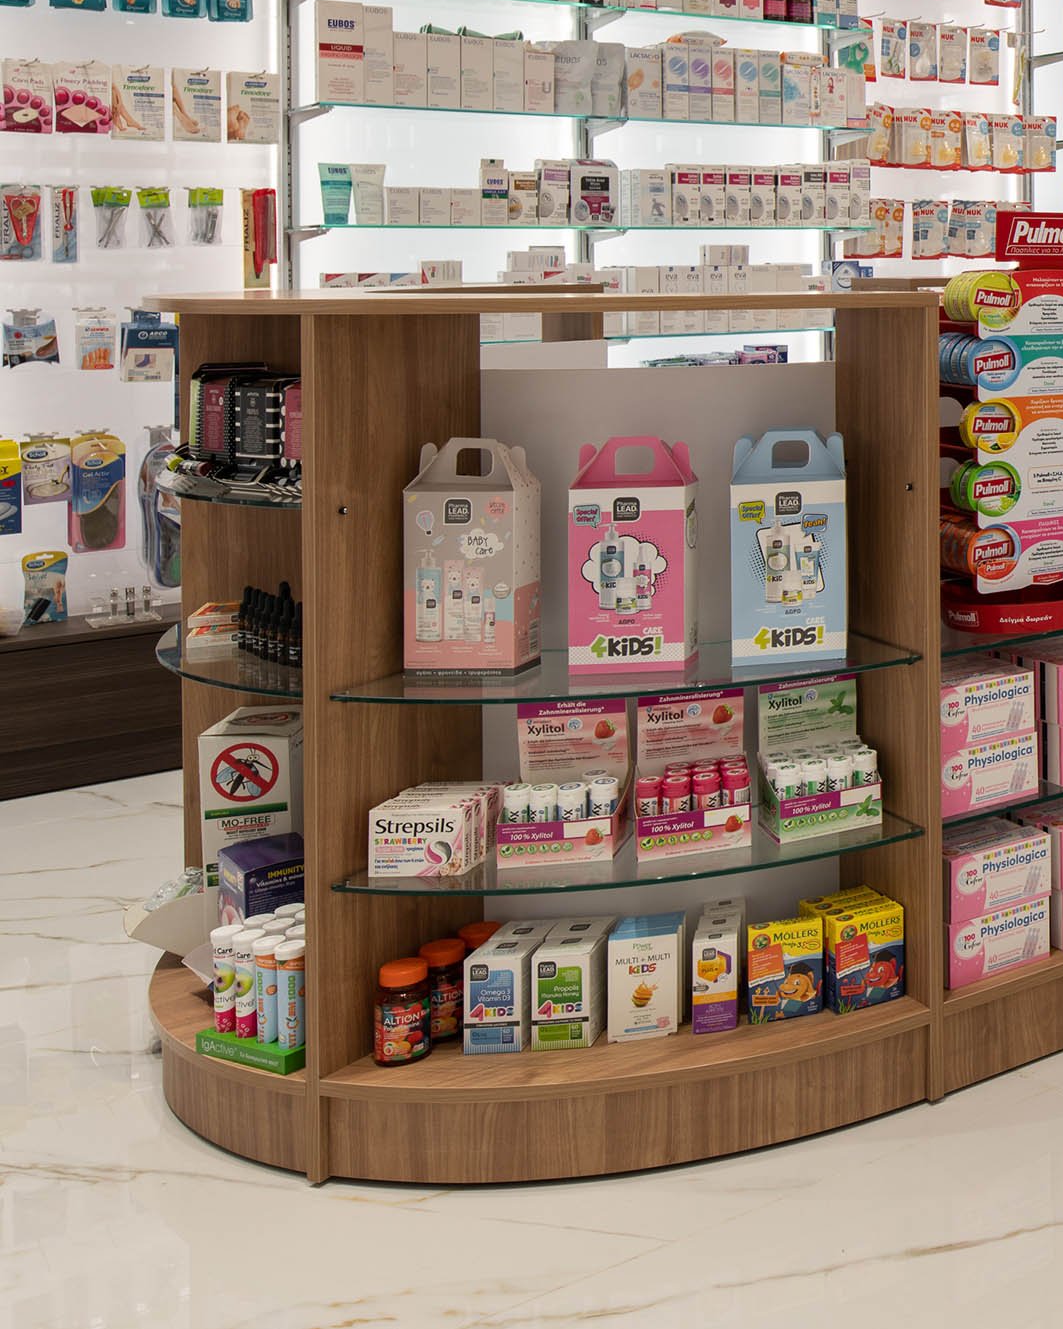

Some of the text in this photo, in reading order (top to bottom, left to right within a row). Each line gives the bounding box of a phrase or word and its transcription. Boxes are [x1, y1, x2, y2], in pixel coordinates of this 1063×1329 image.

[327, 18, 355, 28] EUBOS
[883, 25, 895, 33] NUK
[910, 30, 924, 38] NUK
[941, 33, 954, 41] NUK
[970, 36, 985, 44] NUK
[931, 118, 945, 126] NUK
[994, 121, 1009, 129] NUK
[921, 208, 934, 216] NUK
[966, 208, 982, 216] NUK
[976, 290, 1011, 307] Pulmoll
[976, 353, 1011, 372] Pulmoll
[975, 420, 1010, 431] Pulmoll
[976, 479, 1009, 496] Pulmoll
[779, 499, 799, 507] LEAD
[575, 508, 598, 516] Special
[616, 505, 637, 513] LEAD
[467, 536, 488, 546] BABY
[975, 541, 1010, 559] Pulmoll
[964, 684, 1029, 708] Physiologica
[768, 696, 803, 711] Xylitol
[948, 702, 960, 710] 100
[647, 711, 684, 724] Xylitol
[527, 723, 565, 737] Xylitol
[967, 745, 1033, 769] Physiologica
[950, 763, 963, 772] 100
[792, 802, 832, 815] 100 % Xylitol
[221, 815, 271, 828] MO-FREE
[375, 817, 454, 838] Strepsils
[651, 822, 694, 833] 100 % Xylitol
[375, 837, 427, 845] STRAWBERRY
[531, 832, 554, 841] Xylitol
[982, 847, 1047, 873] Physiologica
[966, 869, 978, 878] 100
[980, 910, 1045, 937] Physiologica
[963, 933, 976, 943] 100
[615, 956, 639, 966] MULTI
[647, 952, 671, 962] MULTI
[480, 989, 505, 997] Omega
[384, 1013, 420, 1025] ALTION
